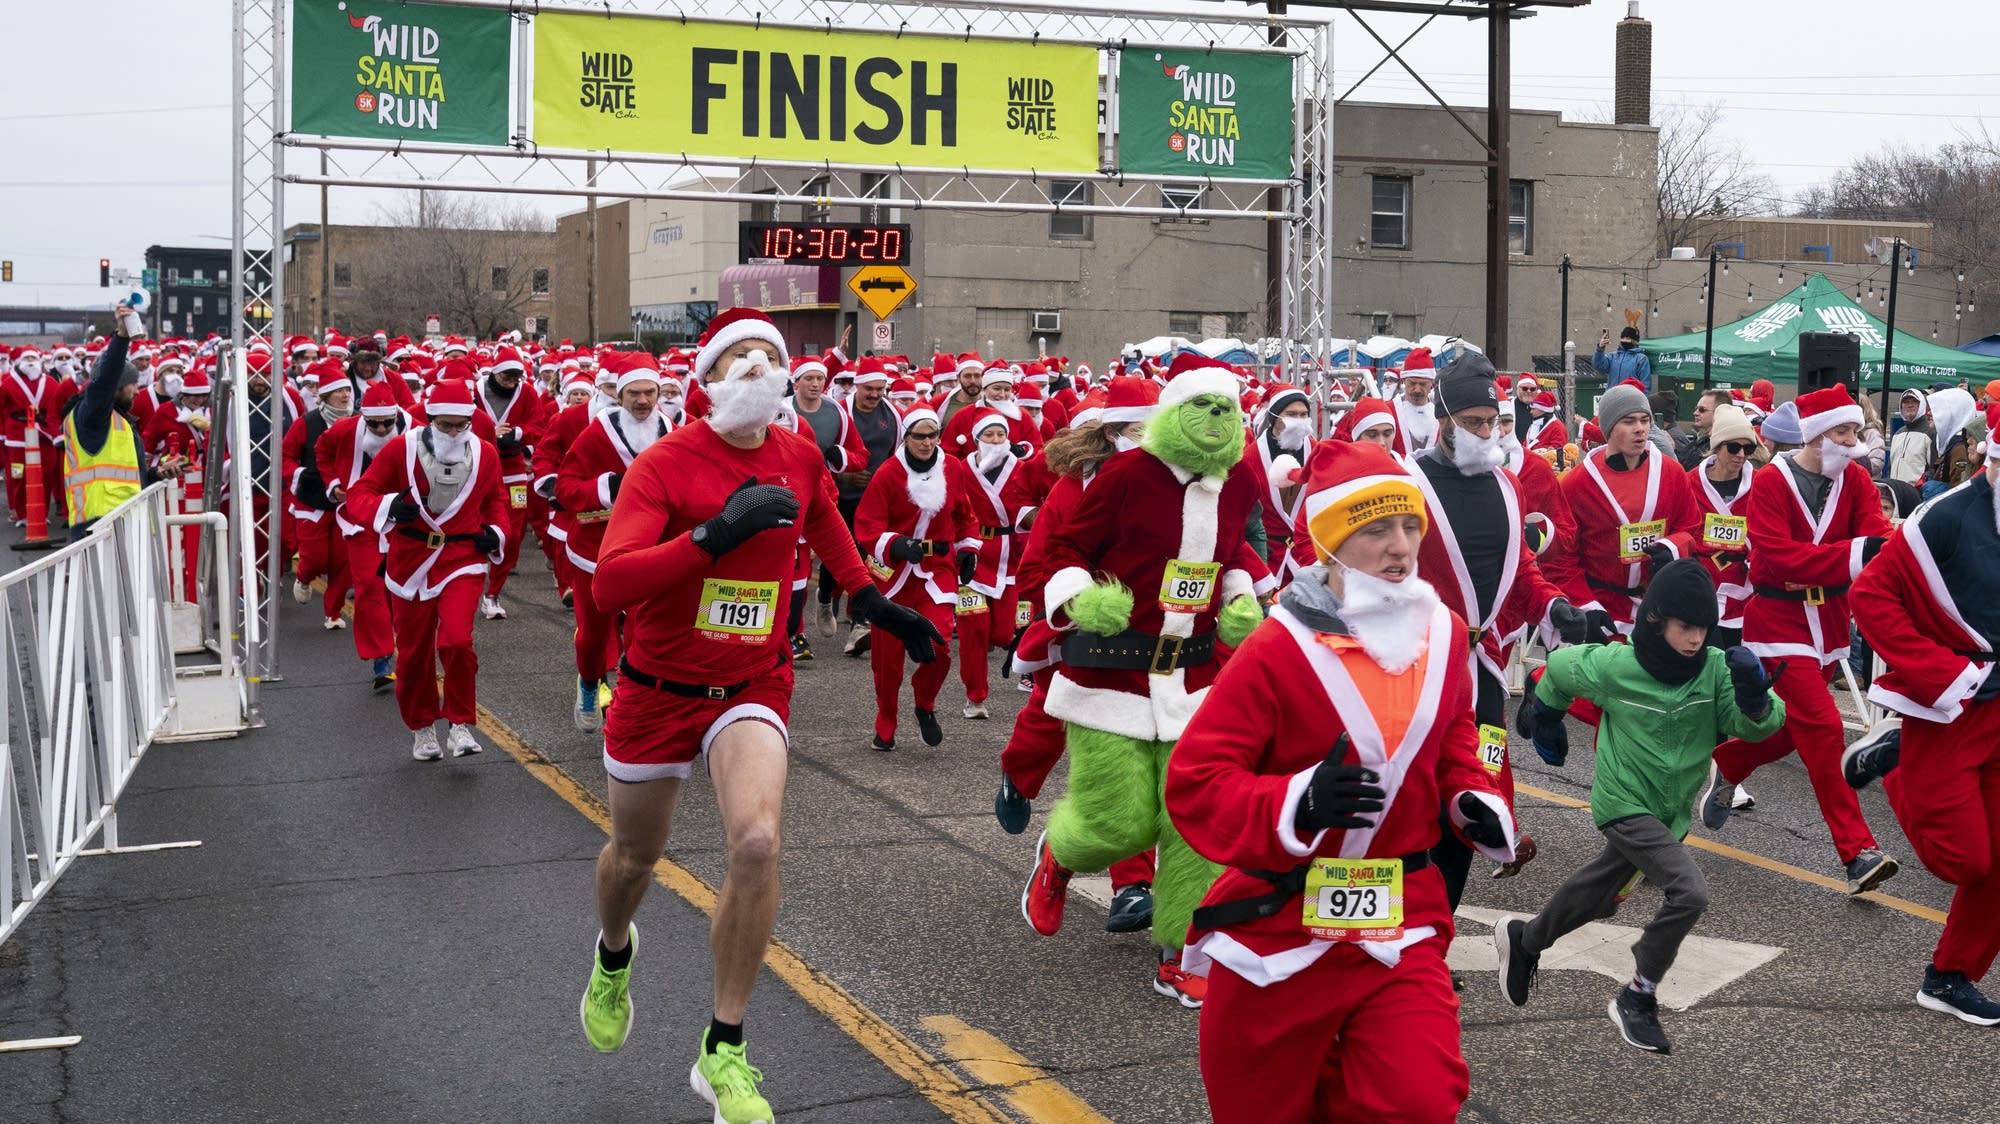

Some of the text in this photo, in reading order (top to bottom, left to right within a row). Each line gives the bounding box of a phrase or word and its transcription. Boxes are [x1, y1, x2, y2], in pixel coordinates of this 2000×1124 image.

[373, 23, 440, 64] WILD
[356, 55, 446, 102] SANTA
[581, 51, 634, 83] WILD
[580, 77, 636, 114] STATE
[691, 47, 958, 147] FINISH
[1007, 77, 1054, 106] WILD
[1182, 71, 1236, 106] WILD
[360, 98, 373, 109] 5K
[378, 92, 438, 130] RUN
[1006, 101, 1056, 135] STATE
[1169, 100, 1240, 141] SANTA
[1172, 140, 1183, 149] 5K
[1187, 133, 1235, 166] RUN
[1759, 302, 1801, 326] WILD
[1815, 305, 1873, 329] WILD
[1911, 365, 1934, 376] CRAFT
[1936, 366, 1957, 377] CIDER
[1347, 503, 1415, 526] CROSS COUNTRY
[1348, 494, 1409, 515] HERMANTOWN
[1713, 526, 1739, 541] 1291
[718, 585, 773, 598] WILD SANTA RUN
[961, 595, 979, 608] 697
[1176, 580, 1206, 599] 897
[719, 603, 759, 627] 1191
[1325, 866, 1394, 880] WILD SANTA RUN
[1329, 888, 1377, 918] 973
[1310, 927, 1326, 936] FREE
[1326, 928, 1347, 937] GLASS
[1377, 928, 1397, 937] GLASS
